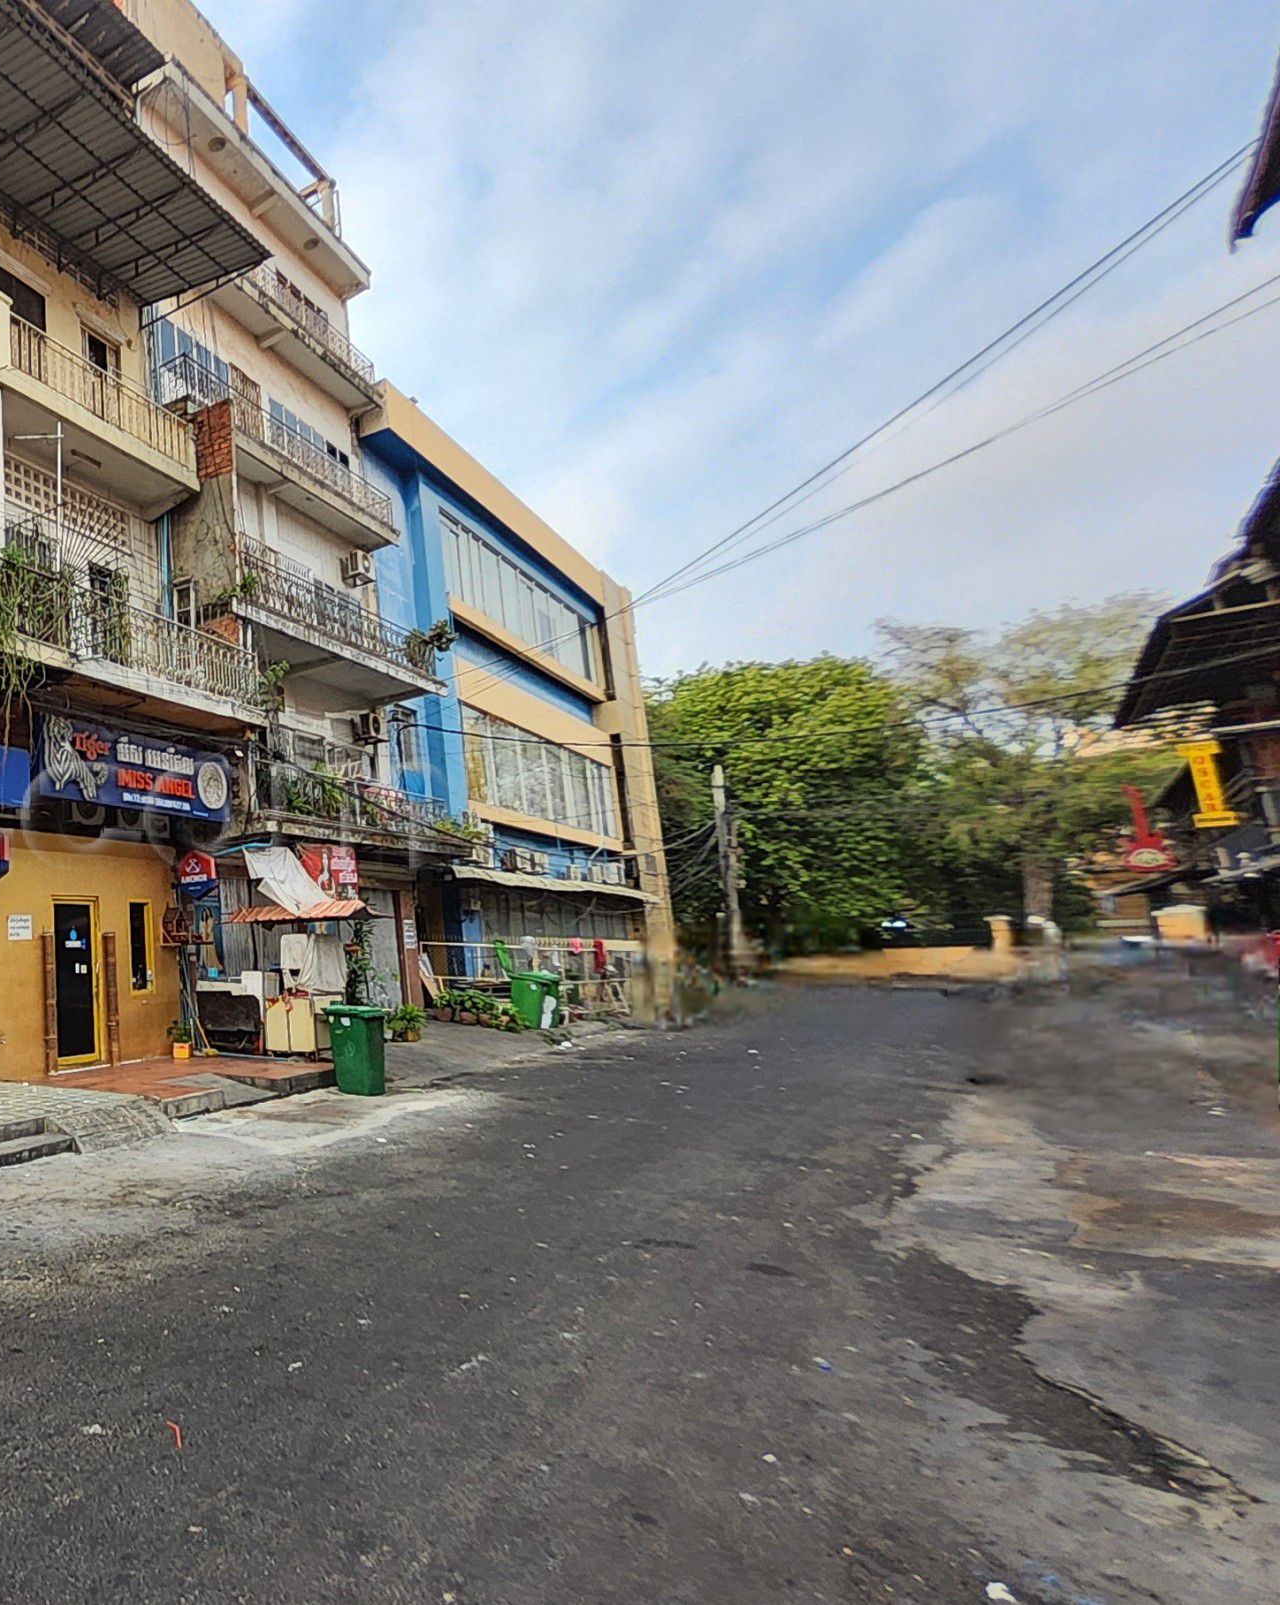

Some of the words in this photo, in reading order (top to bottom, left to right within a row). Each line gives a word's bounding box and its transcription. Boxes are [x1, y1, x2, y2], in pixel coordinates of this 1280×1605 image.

[72, 731, 112, 761] Tiger
[117, 768, 153, 791] MISS
[154, 774, 196, 800] ANGEL
